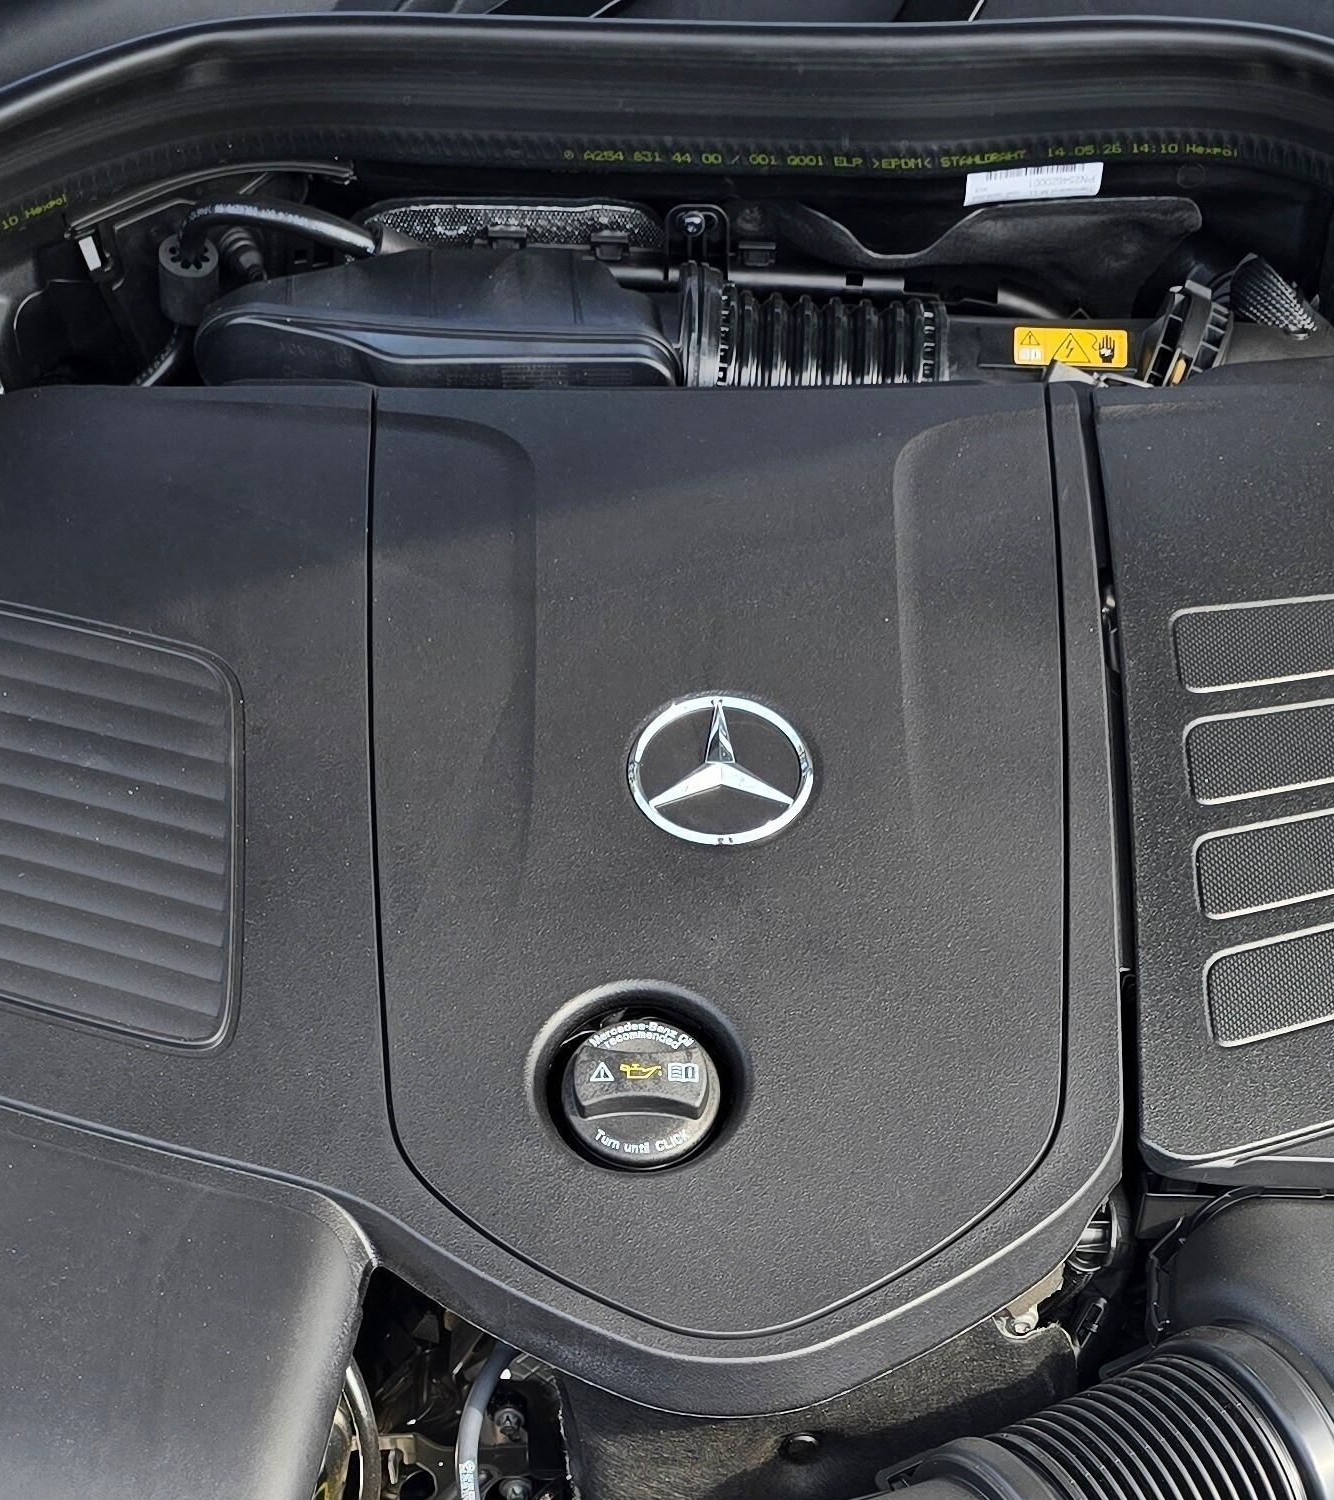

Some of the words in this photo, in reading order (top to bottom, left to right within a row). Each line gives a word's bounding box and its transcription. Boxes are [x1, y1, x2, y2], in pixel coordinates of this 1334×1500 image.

[584, 150, 624, 161] A254
[671, 152, 691, 164] 44
[701, 153, 722, 165] 00
[588, 1021, 678, 1048] Mercedes-Benz
[602, 1030, 682, 1050] recommended
[594, 1128, 620, 1150] Turn
[624, 1141, 650, 1154] until
[655, 1128, 691, 1152] CLICK
